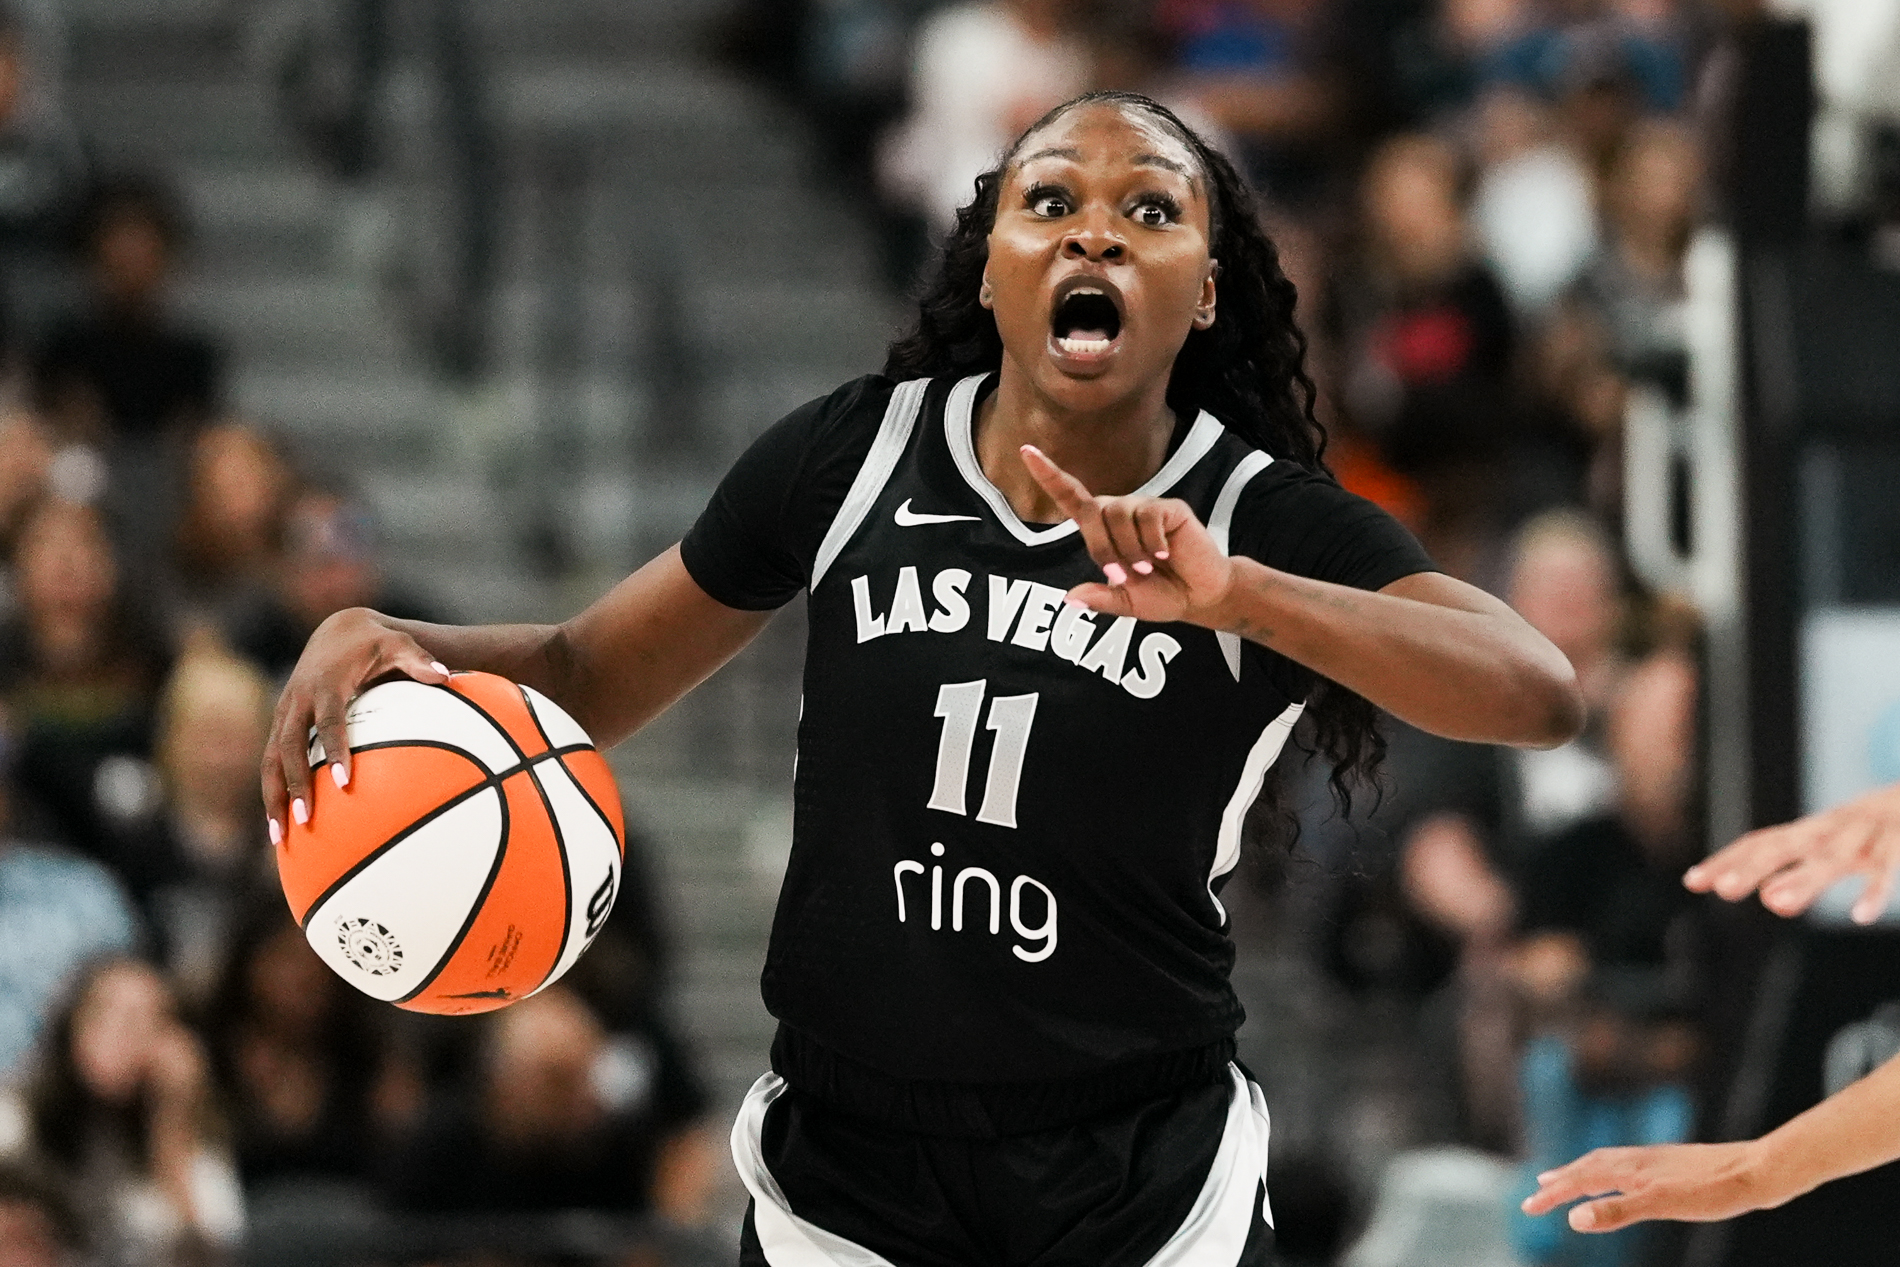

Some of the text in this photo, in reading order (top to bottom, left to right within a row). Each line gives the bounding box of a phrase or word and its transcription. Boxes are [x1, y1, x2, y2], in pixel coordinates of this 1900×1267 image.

[851, 566, 1182, 699] LAS VEGAS
[927, 679, 1039, 829] 11
[894, 842, 1057, 962] ring
